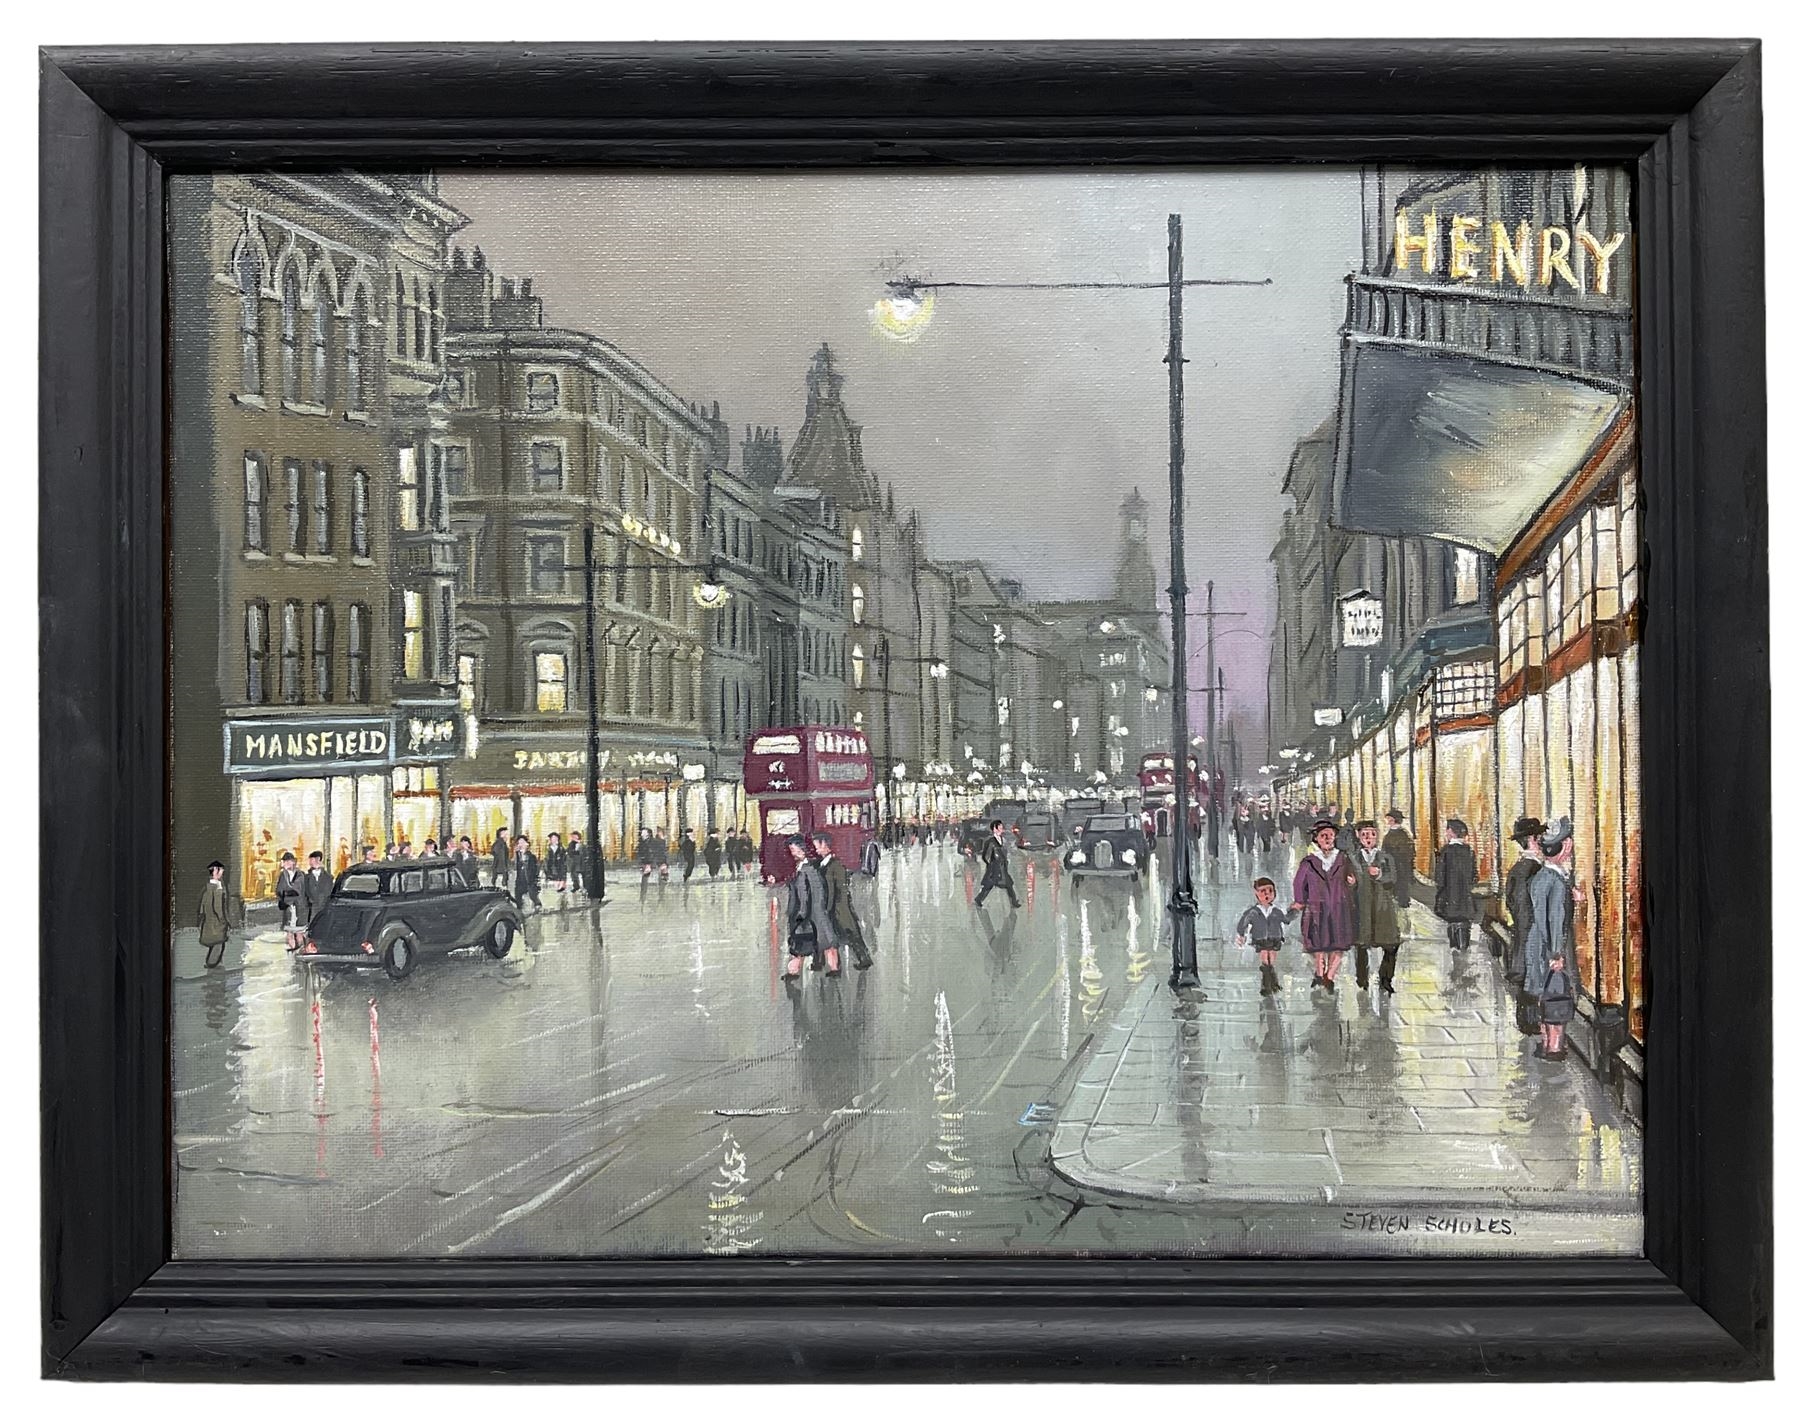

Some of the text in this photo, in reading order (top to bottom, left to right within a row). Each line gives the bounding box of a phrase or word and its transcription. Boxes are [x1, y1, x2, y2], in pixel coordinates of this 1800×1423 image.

[1395, 207, 1625, 295] HENRY
[246, 729, 387, 758] MANSFIELD
[1341, 1211, 1409, 1234] STEVEN
